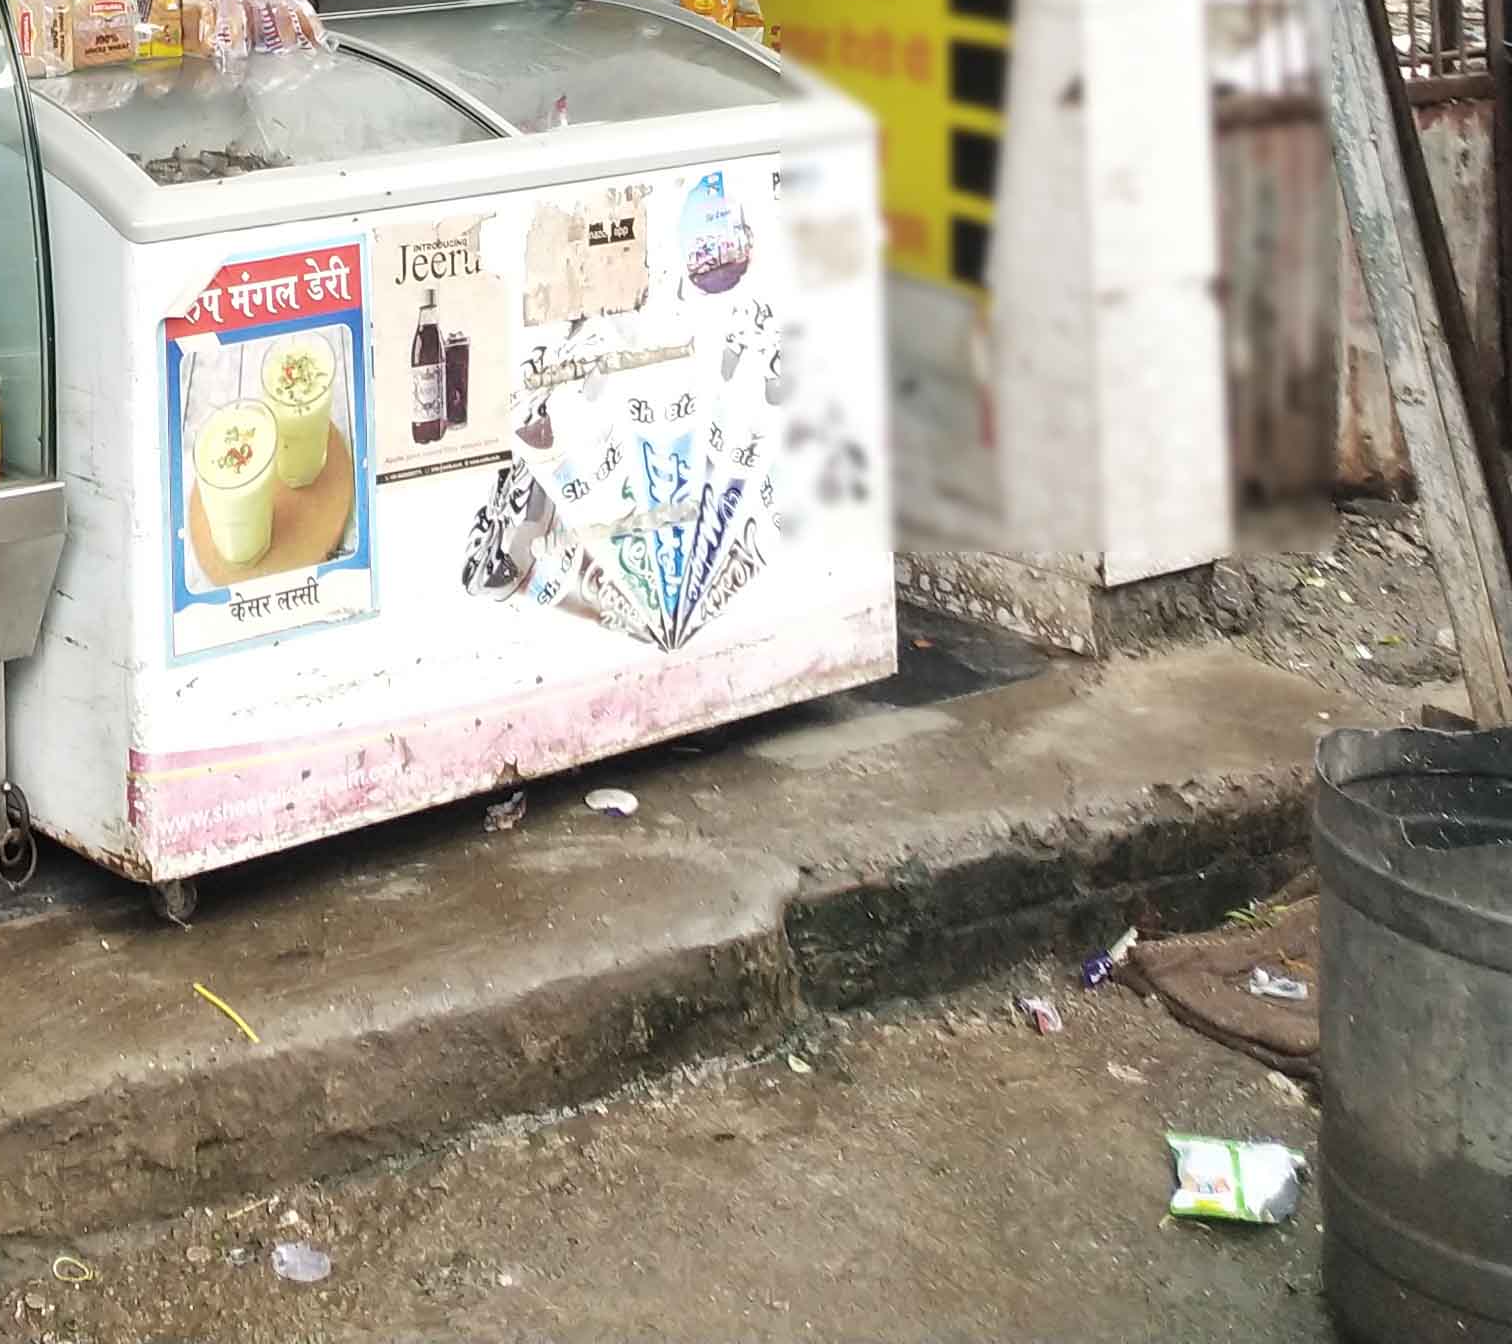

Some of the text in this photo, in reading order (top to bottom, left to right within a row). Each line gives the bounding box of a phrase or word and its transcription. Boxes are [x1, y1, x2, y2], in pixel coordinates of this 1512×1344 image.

[413, 238, 470, 253] INTRODUCING
[230, 271, 301, 319] मंगल
[305, 253, 354, 302] डेरी
[230, 575, 321, 622] केसर लस्सी
